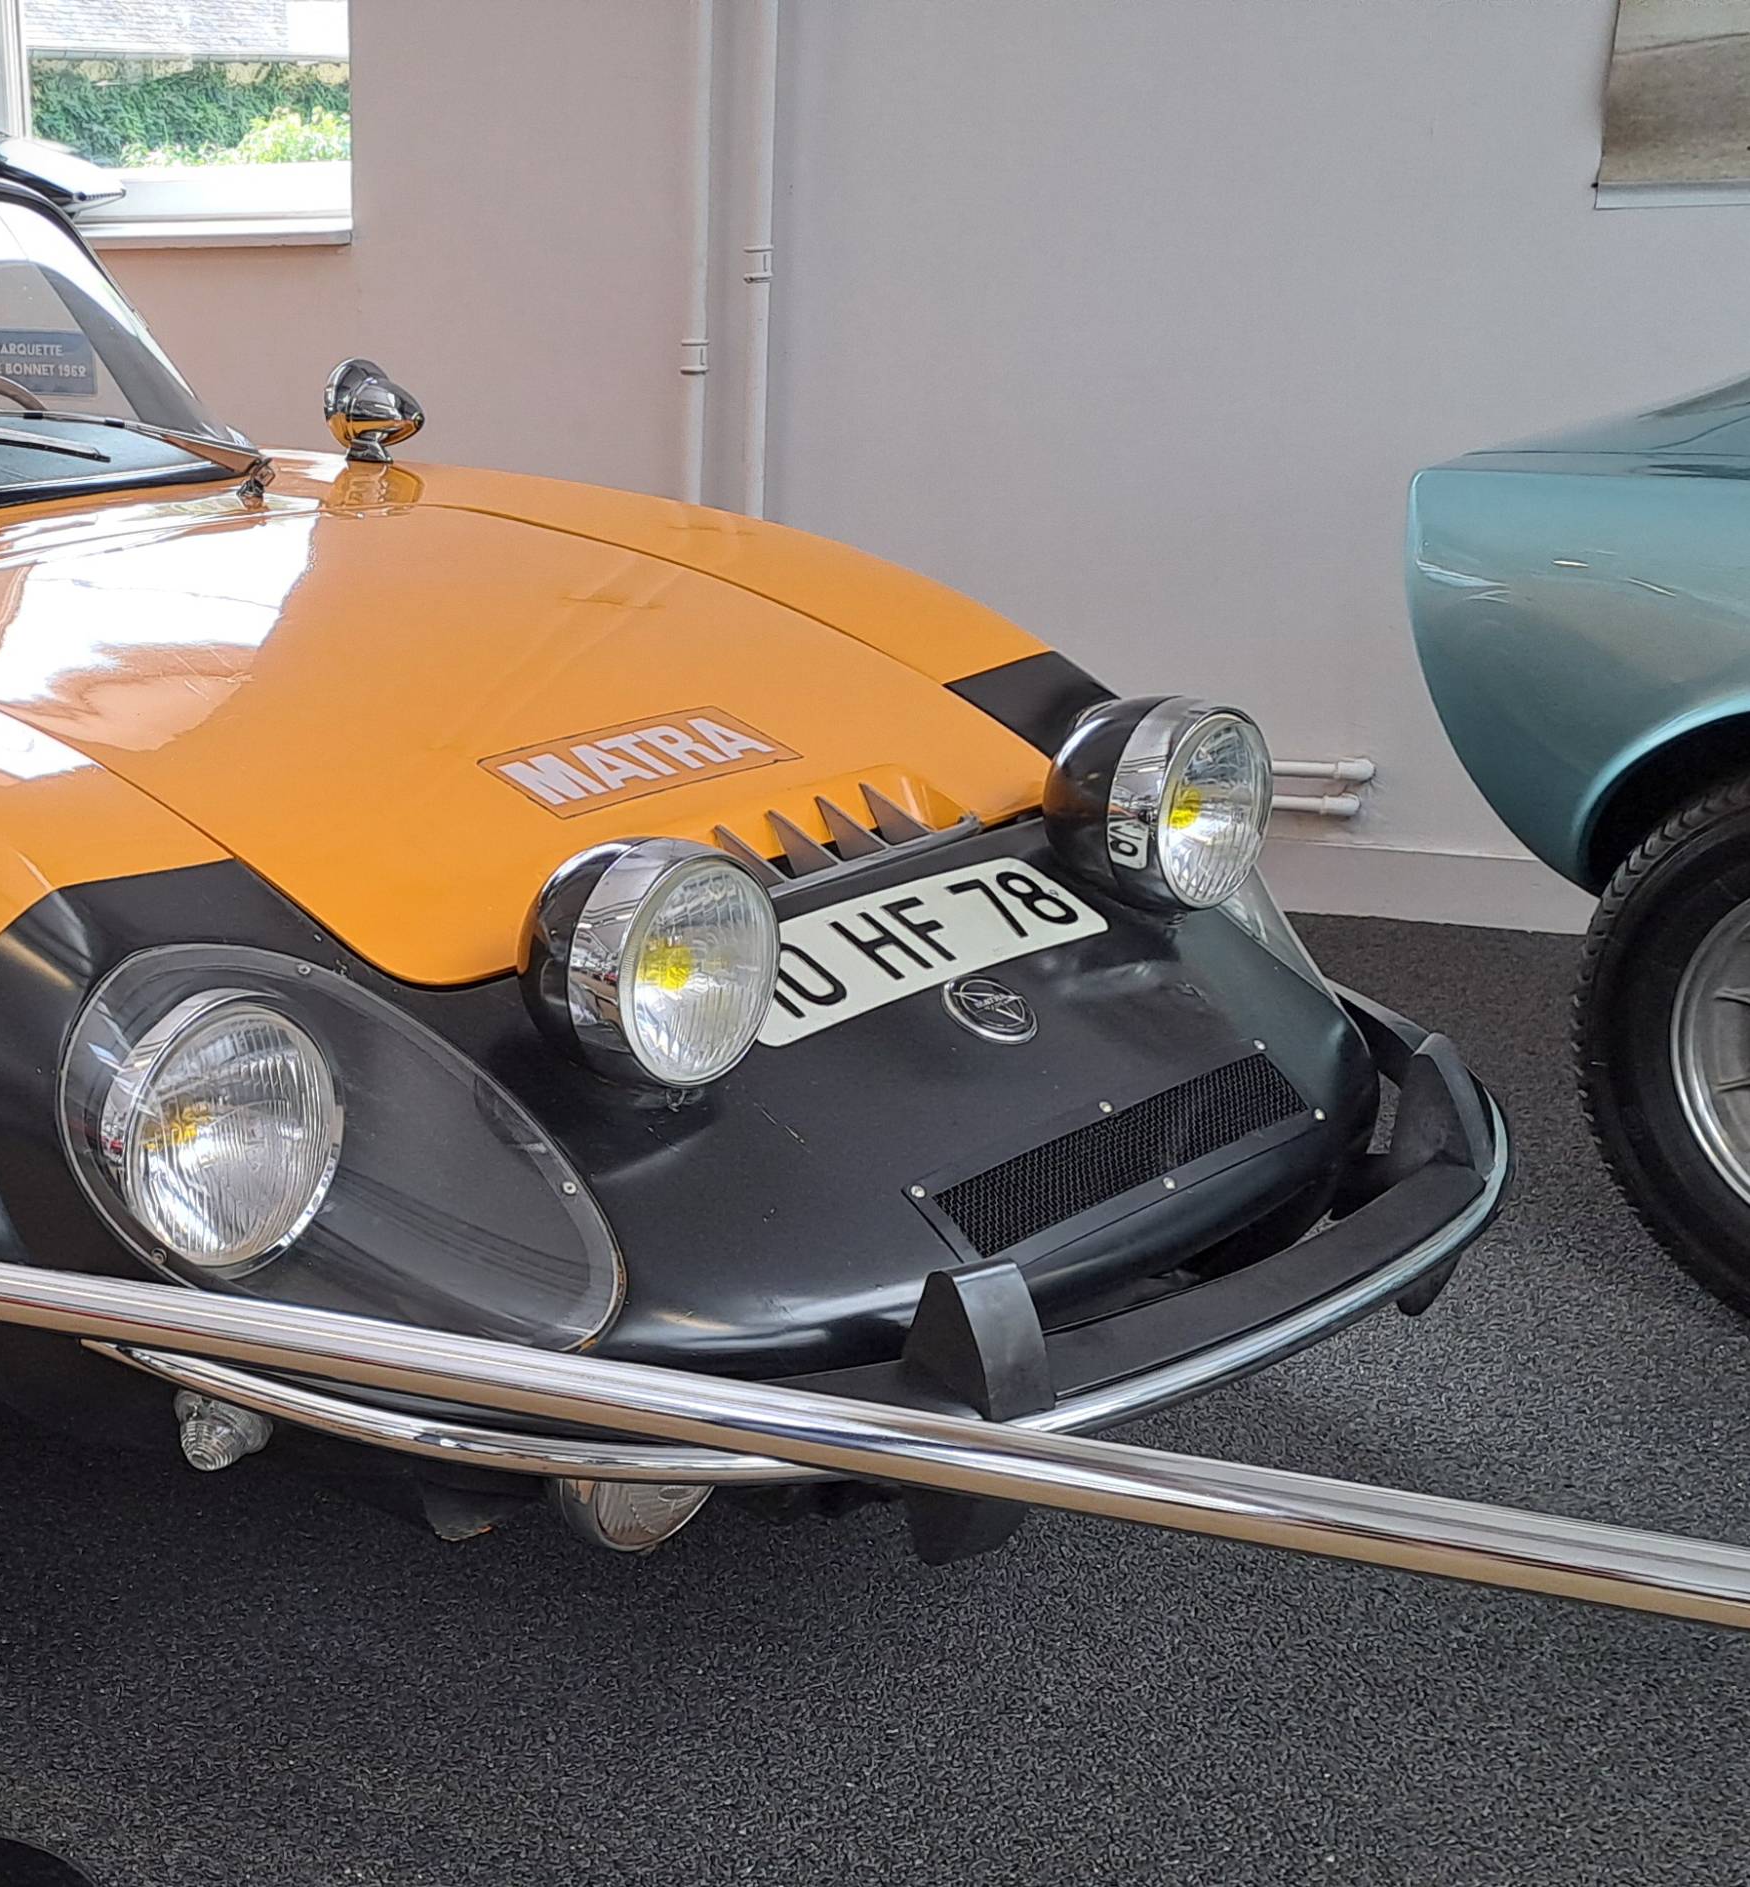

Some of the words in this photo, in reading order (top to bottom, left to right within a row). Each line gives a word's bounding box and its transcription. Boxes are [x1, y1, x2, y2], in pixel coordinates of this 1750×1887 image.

[5, 363, 54, 376] BONNET
[497, 717, 777, 806] MATRA
[829, 896, 956, 980] HF
[945, 871, 1079, 938] 78
